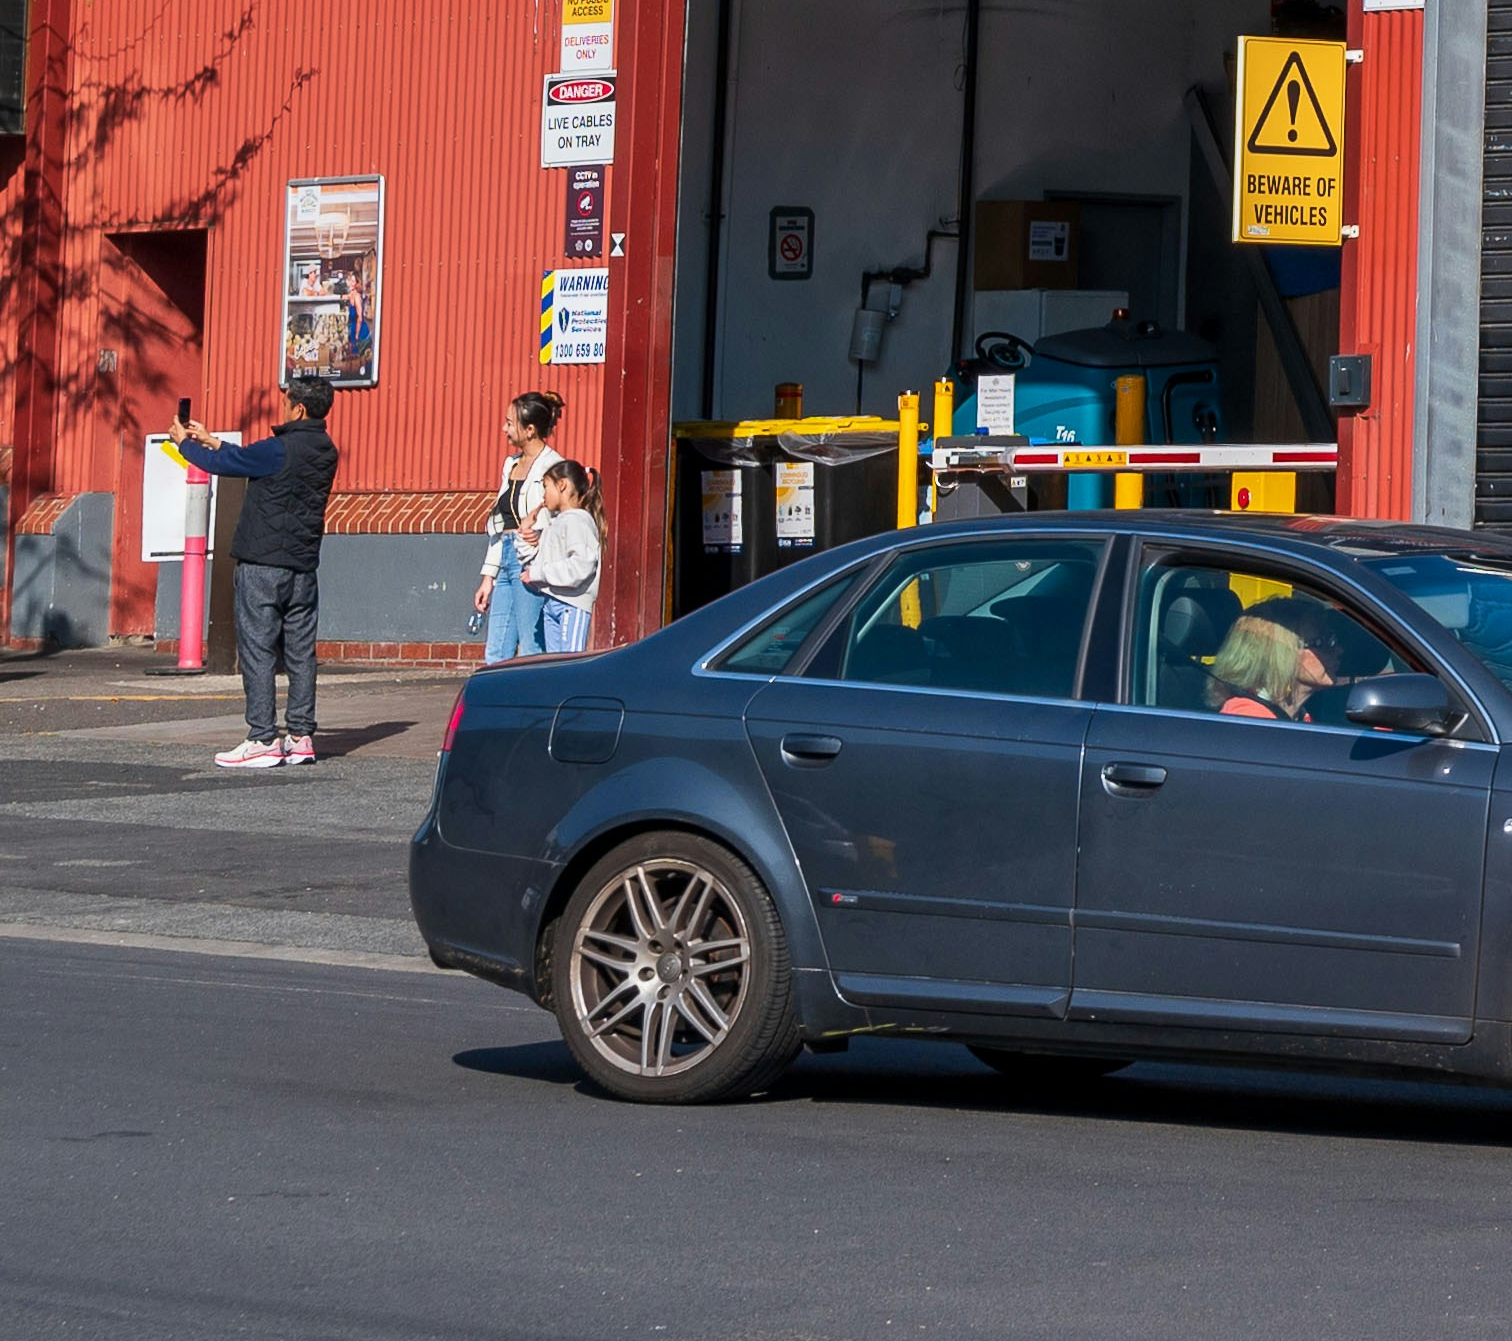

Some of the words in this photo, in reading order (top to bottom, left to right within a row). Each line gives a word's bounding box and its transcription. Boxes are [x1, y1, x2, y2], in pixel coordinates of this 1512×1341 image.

[572, 5, 603, 17] ACCESS
[564, 35, 609, 47] DELIVERIES
[576, 49, 597, 59] ONLY
[559, 83, 604, 99] DANGER
[548, 116, 569, 130] LIVE
[572, 114, 613, 129] CABLES
[558, 136, 573, 149] ON
[576, 134, 601, 147] TRAY
[1247, 174, 1311, 196] BEWARE
[1317, 177, 1336, 197] OF
[1254, 204, 1327, 226] VEHICLES
[556, 344, 573, 357] 1300
[576, 344, 590, 357] 659
[1056, 425, 1076, 443] T16
